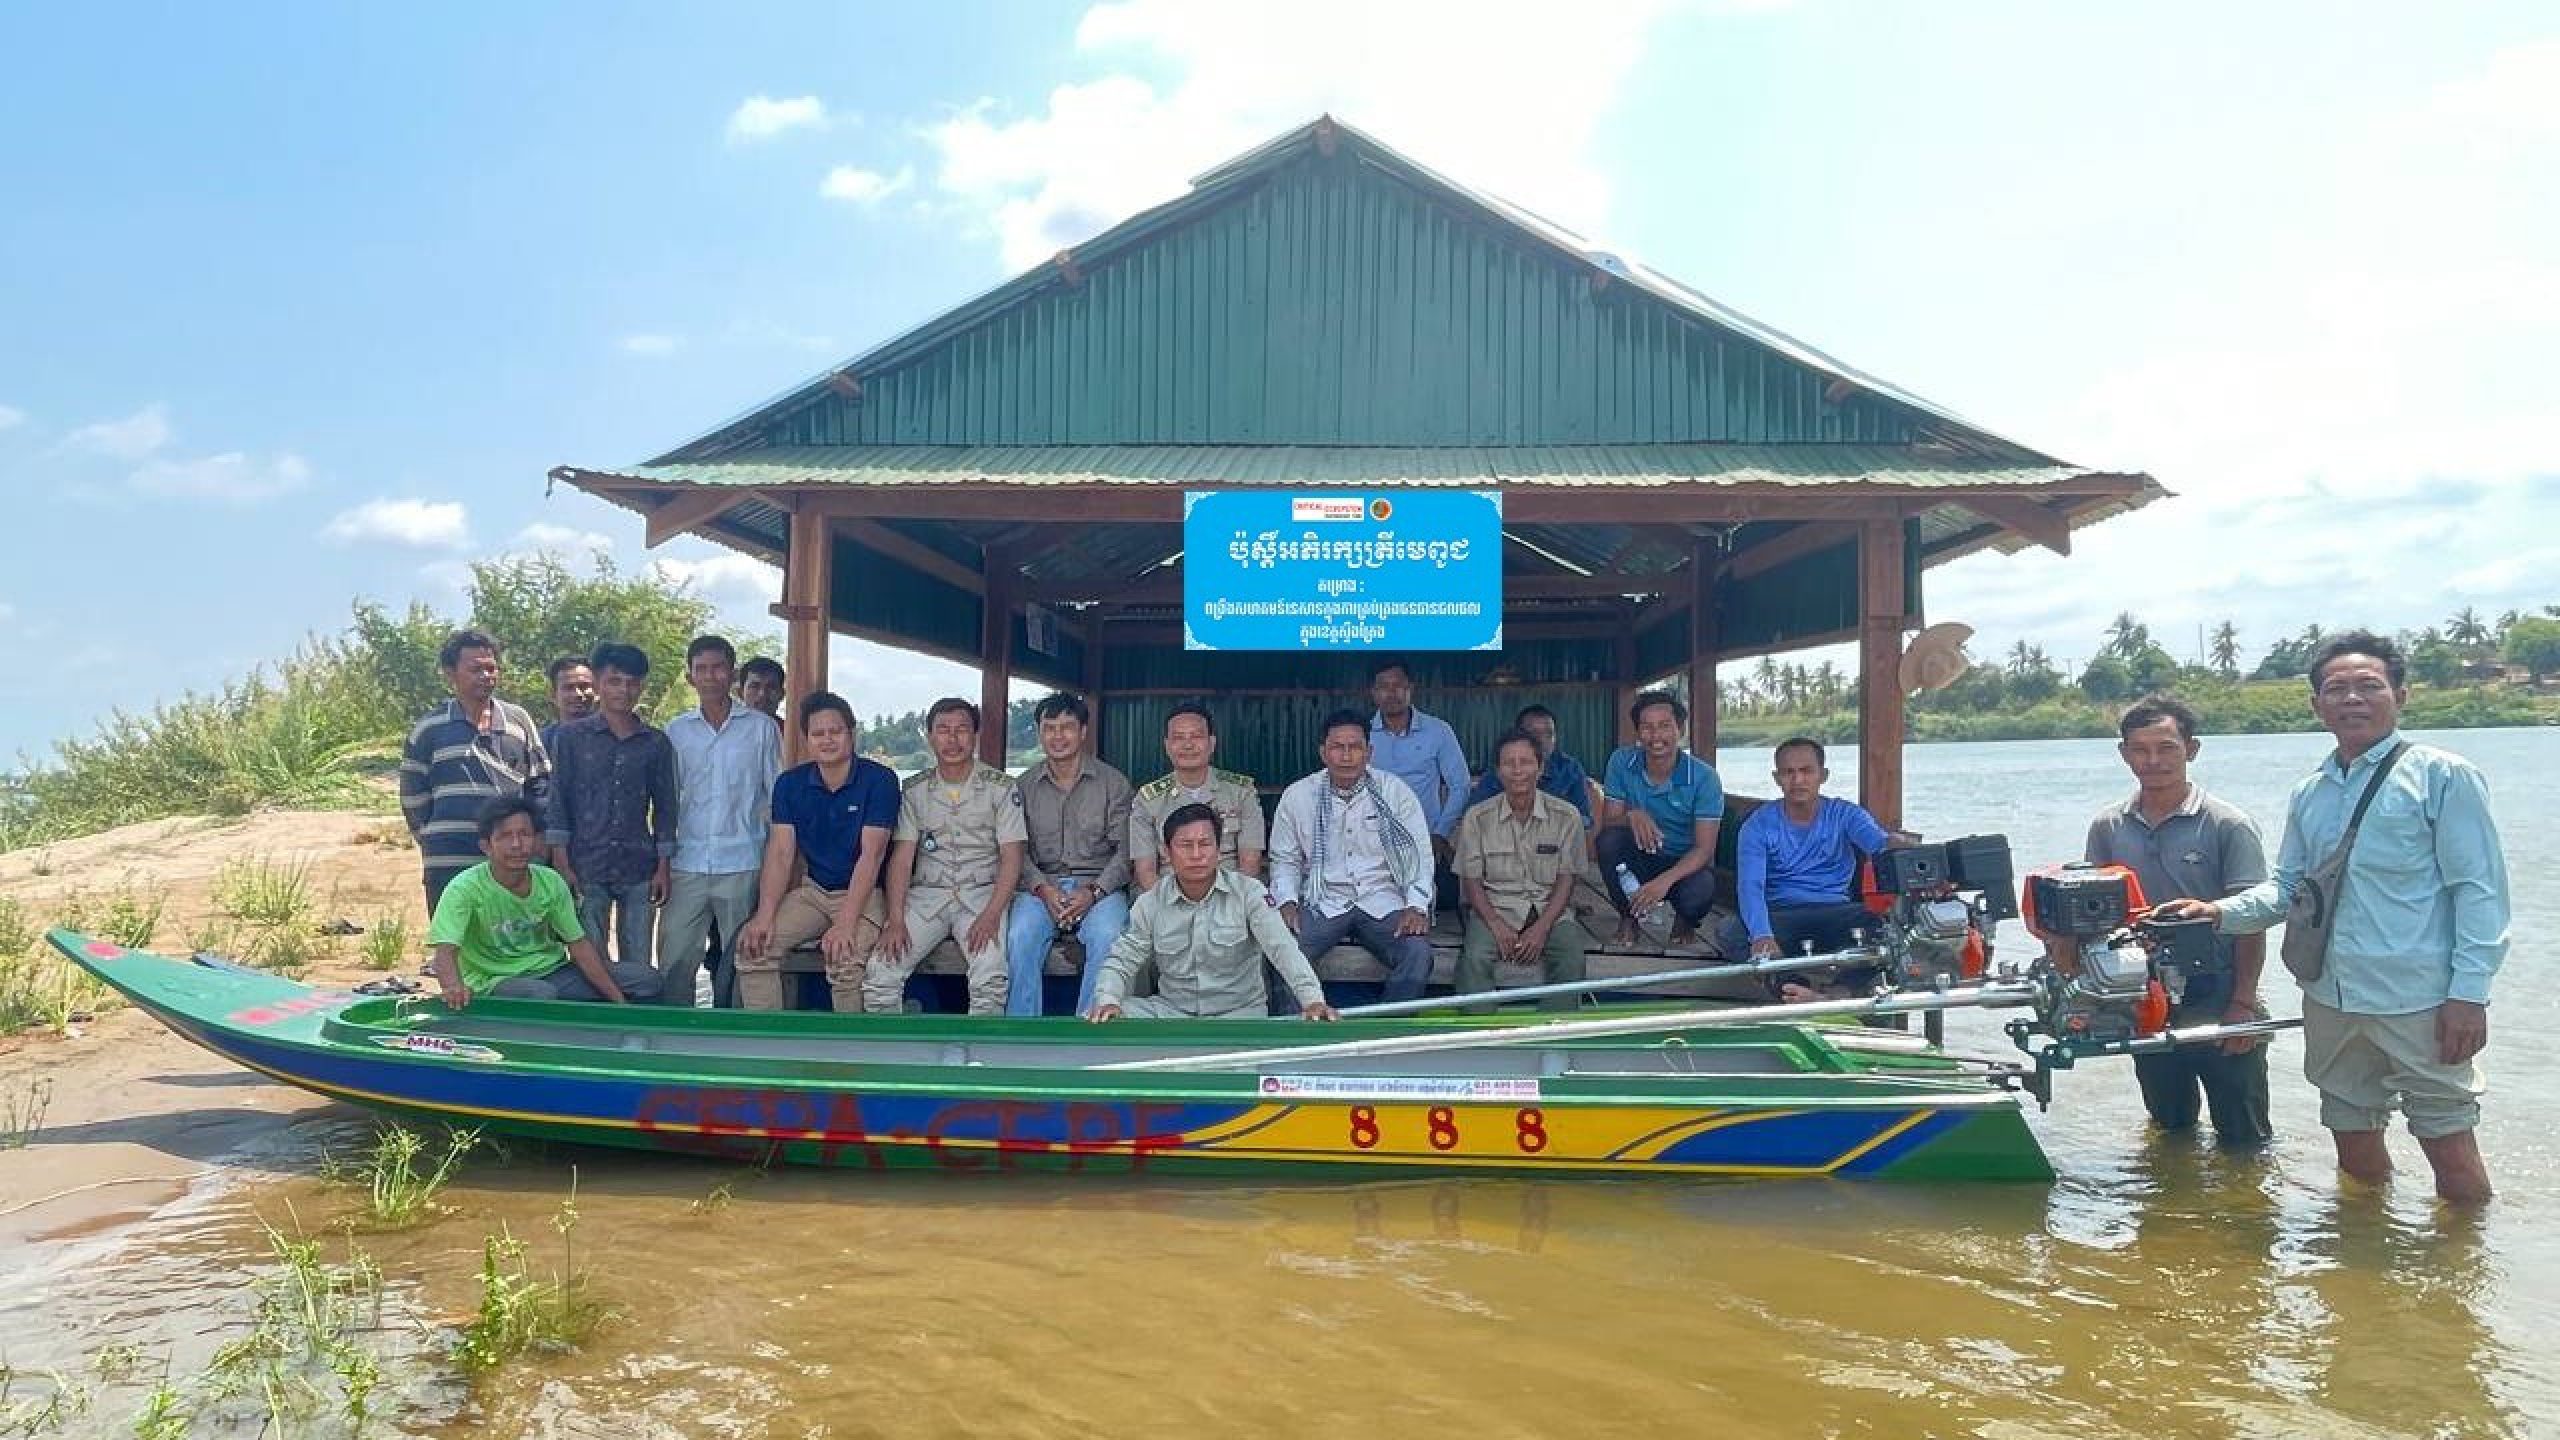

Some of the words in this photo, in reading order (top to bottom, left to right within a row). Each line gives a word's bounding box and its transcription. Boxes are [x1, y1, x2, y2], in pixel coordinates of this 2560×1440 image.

[1350, 1105, 1379, 1149] 8
[1428, 1105, 1458, 1150] 8
[1516, 1107, 1547, 1152] 8
